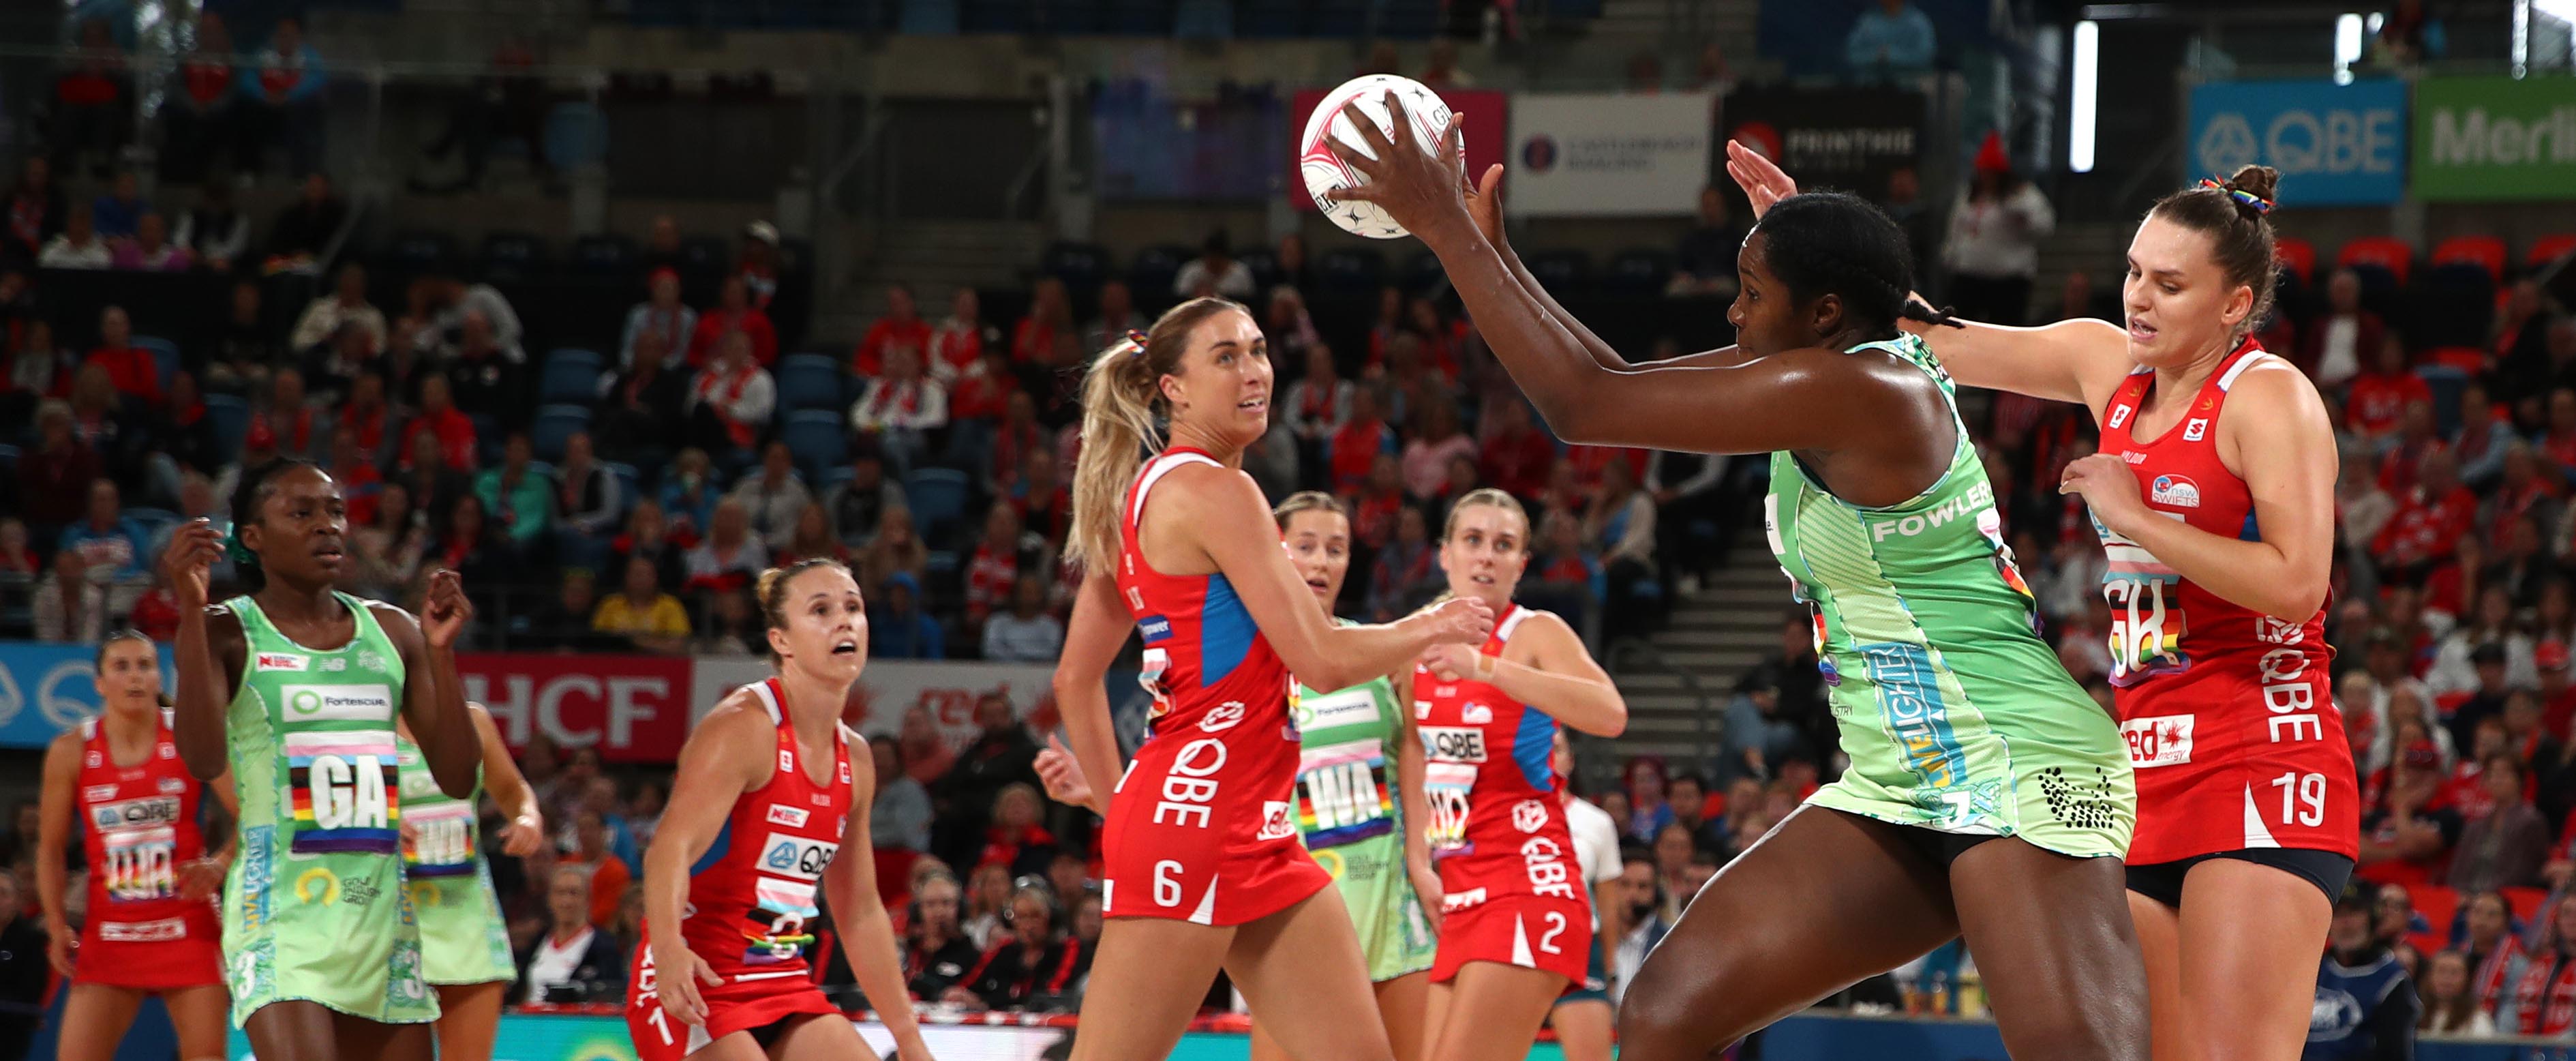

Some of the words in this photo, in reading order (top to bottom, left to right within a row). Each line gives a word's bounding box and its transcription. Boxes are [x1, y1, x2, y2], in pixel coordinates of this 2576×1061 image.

[2266, 108, 2395, 174] QBE
[2153, 492, 2199, 507] SWIFTS
[2104, 578, 2180, 678] GK
[464, 672, 670, 748] HCF
[2258, 648, 2323, 743] QBE
[1437, 732, 1483, 758] QBE
[2121, 721, 2159, 762] ed
[309, 754, 388, 830] GA
[1153, 738, 1227, 828] QBE
[1305, 762, 1383, 831] WA
[2272, 772, 2327, 828] 19
[800, 845, 837, 875] QB
[1153, 859, 1184, 908] 6
[1539, 910, 1567, 955] 2
[235, 950, 257, 1000] 3
[648, 1006, 675, 1047] 1
